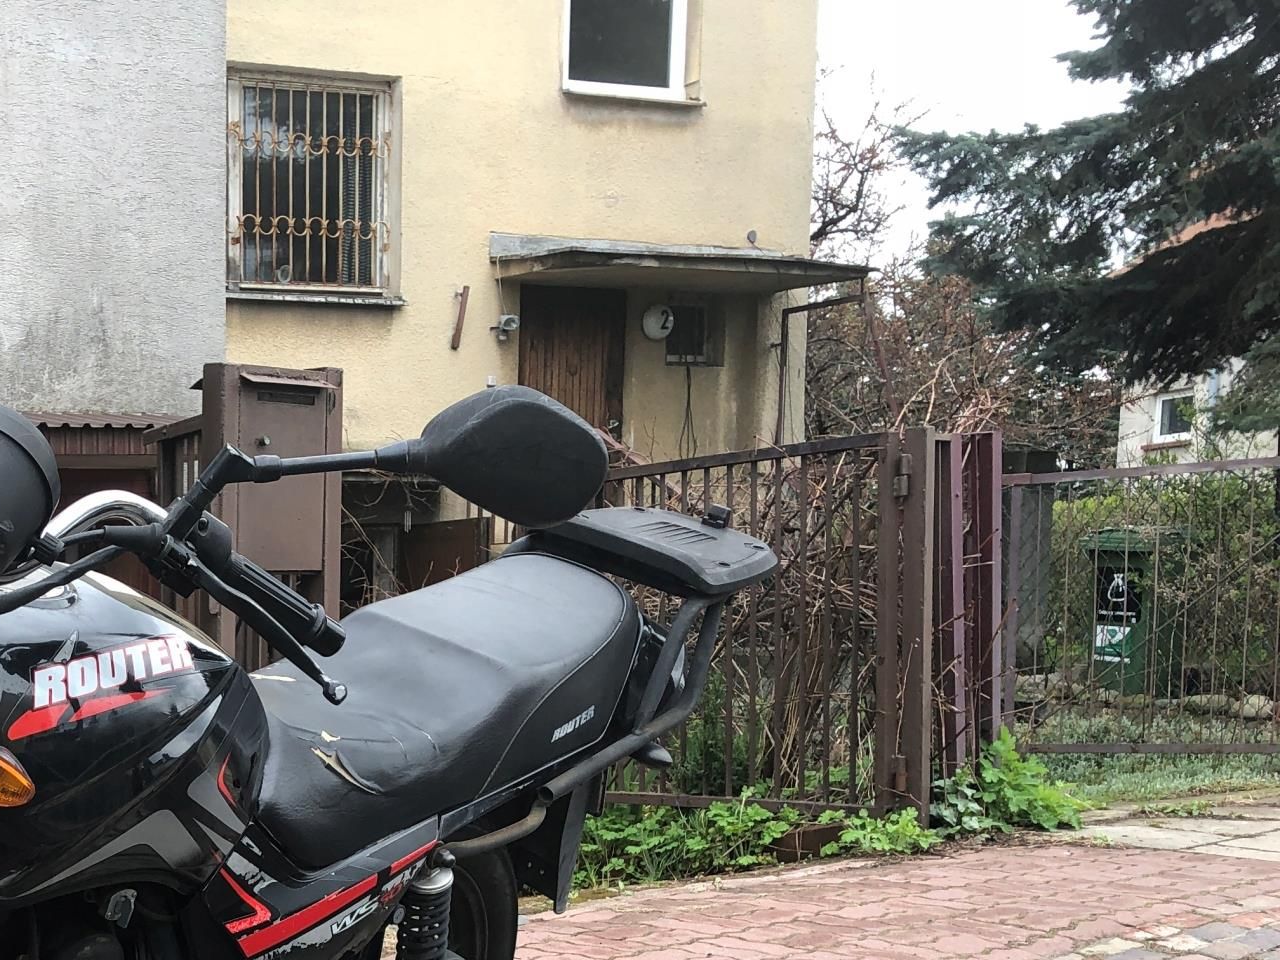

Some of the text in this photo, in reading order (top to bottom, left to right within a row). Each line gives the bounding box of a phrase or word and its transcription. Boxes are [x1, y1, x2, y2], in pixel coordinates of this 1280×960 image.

[661, 310, 670, 330] 2
[33, 636, 193, 708] ROUTER
[551, 705, 595, 743] ROUTER
